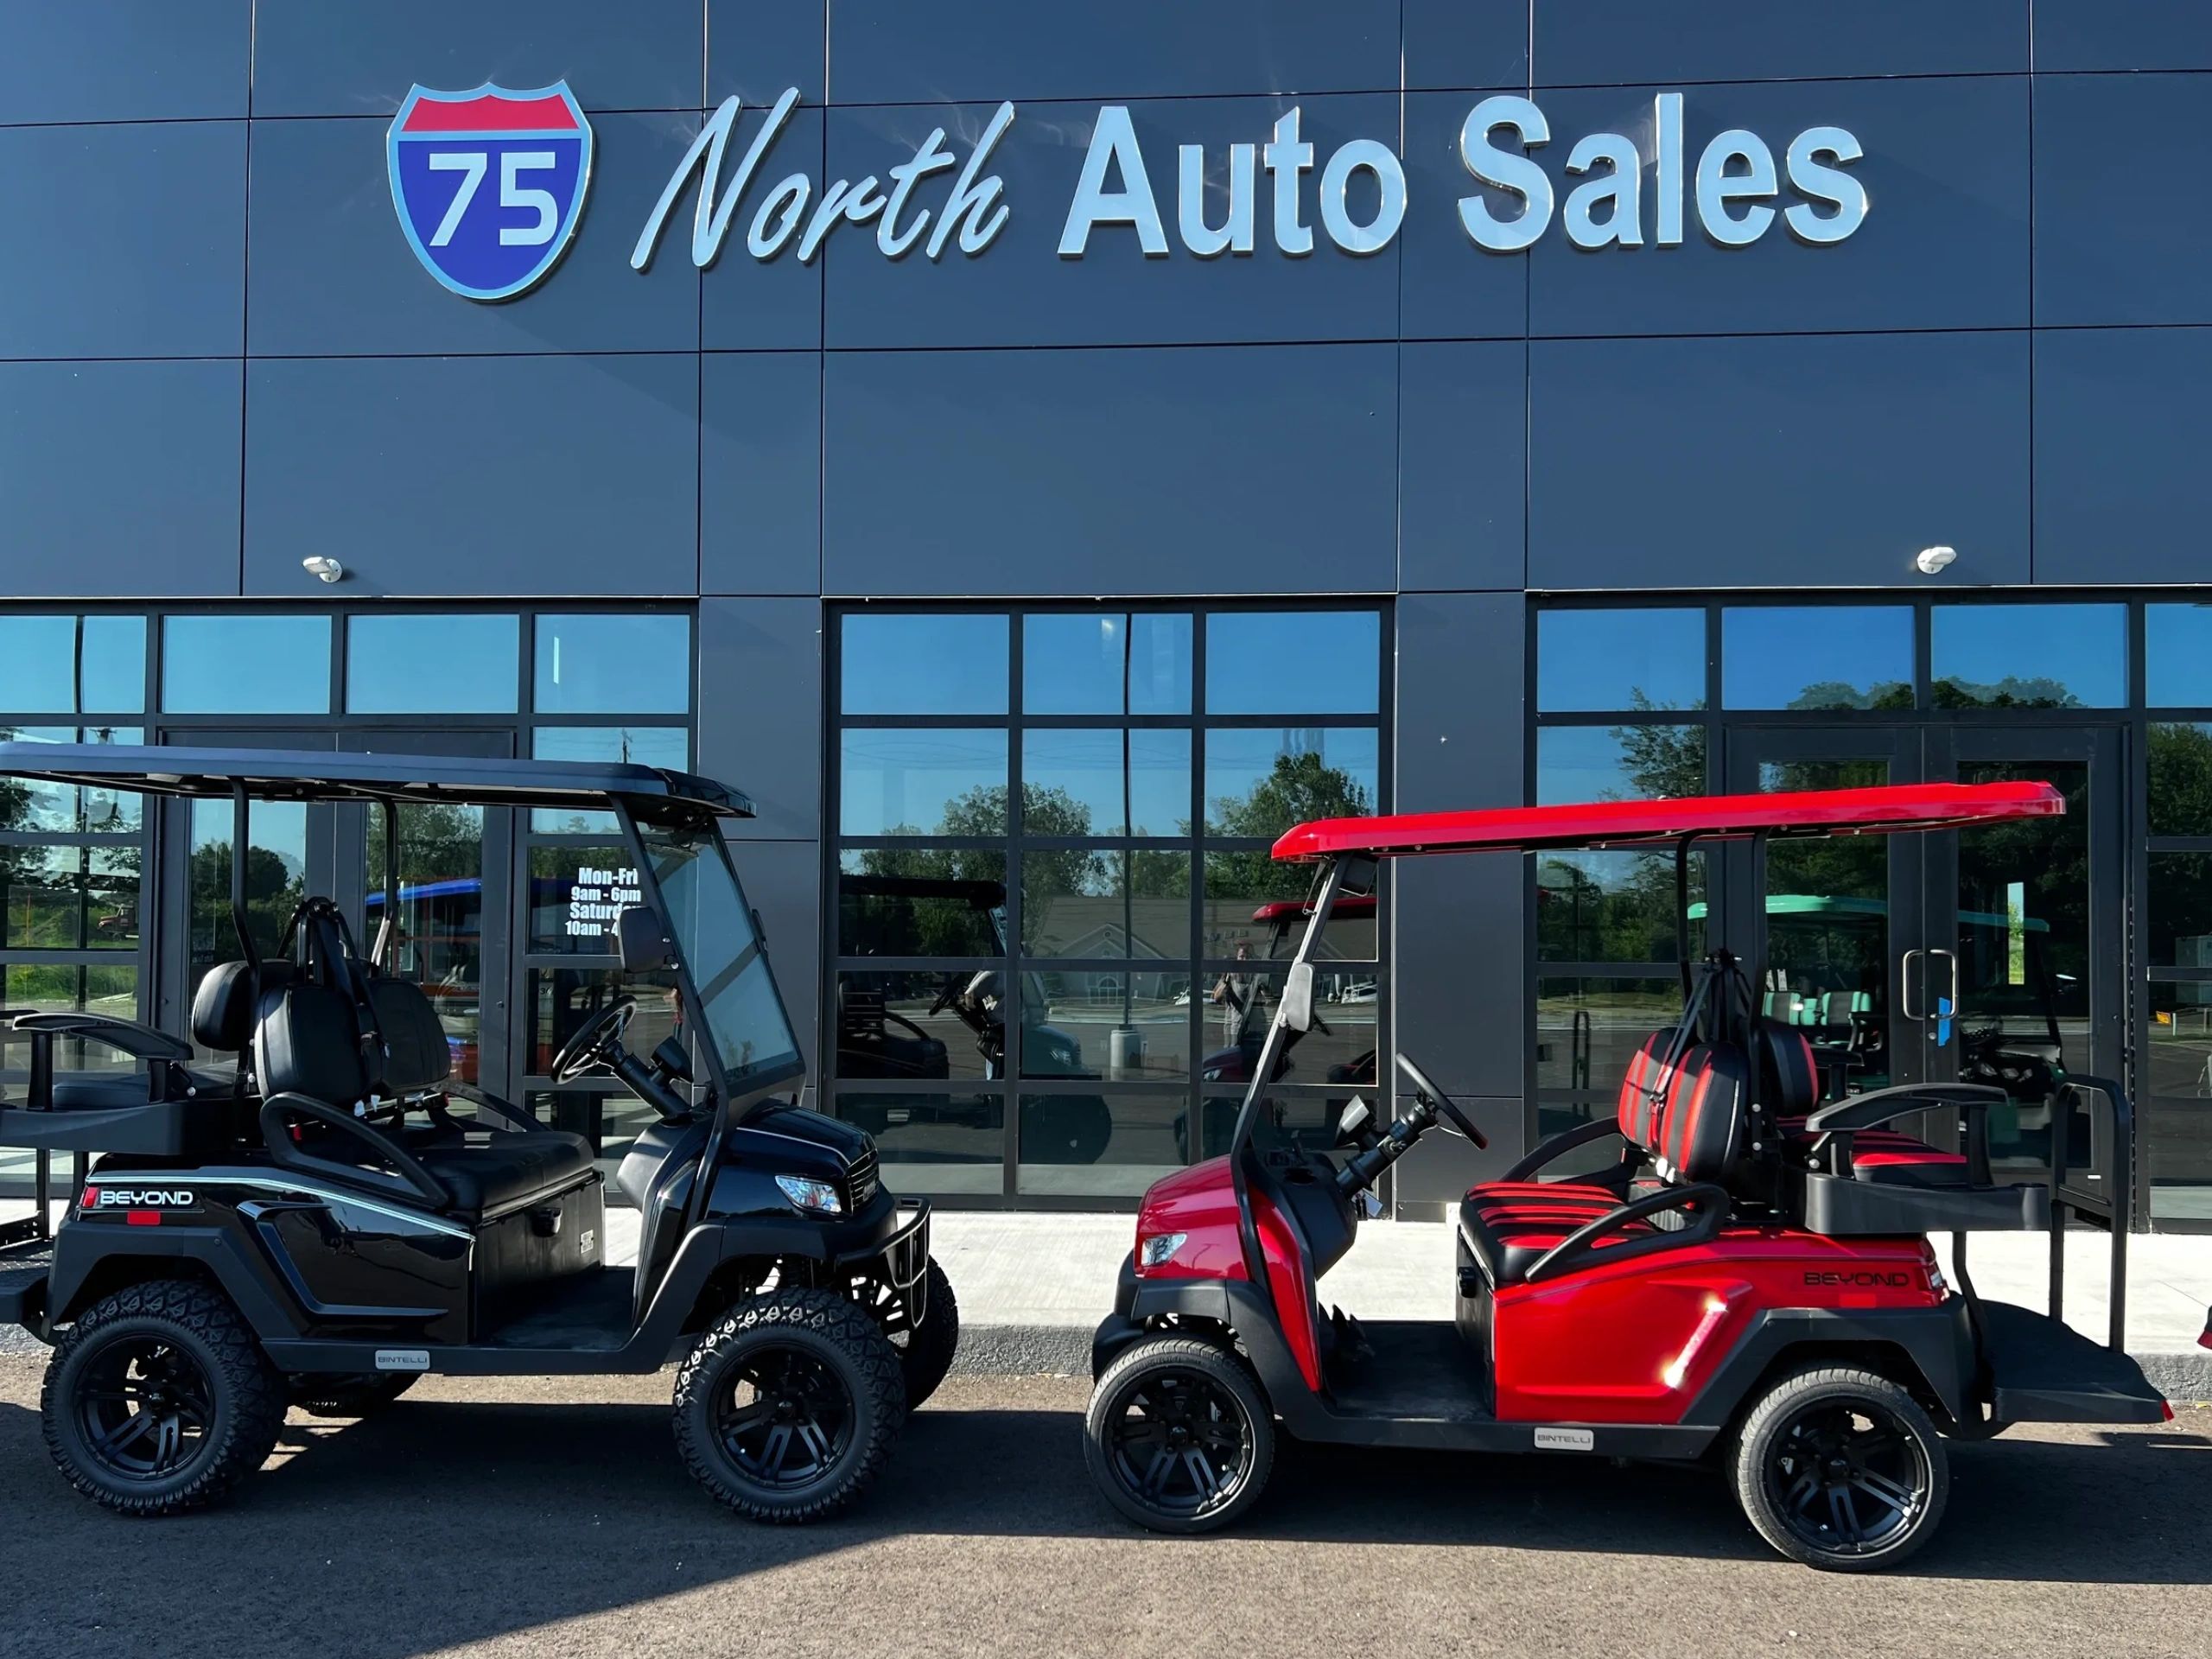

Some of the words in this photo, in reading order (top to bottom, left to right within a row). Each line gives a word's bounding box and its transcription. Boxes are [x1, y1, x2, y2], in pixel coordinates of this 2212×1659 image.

[630, 86, 1016, 271] North
[1057, 105, 1408, 257] Auto
[1457, 92, 1869, 255] Sales
[429, 151, 559, 247] 75
[578, 867, 638, 885] Mon-Fri
[570, 886, 601, 901] 9am
[611, 887, 641, 902] 6pm
[565, 920, 601, 936] 10am
[99, 1191, 194, 1205] BEYOND
[1804, 1272, 1909, 1287] BEYOND
[1537, 1434, 1591, 1444] BINTELLI
